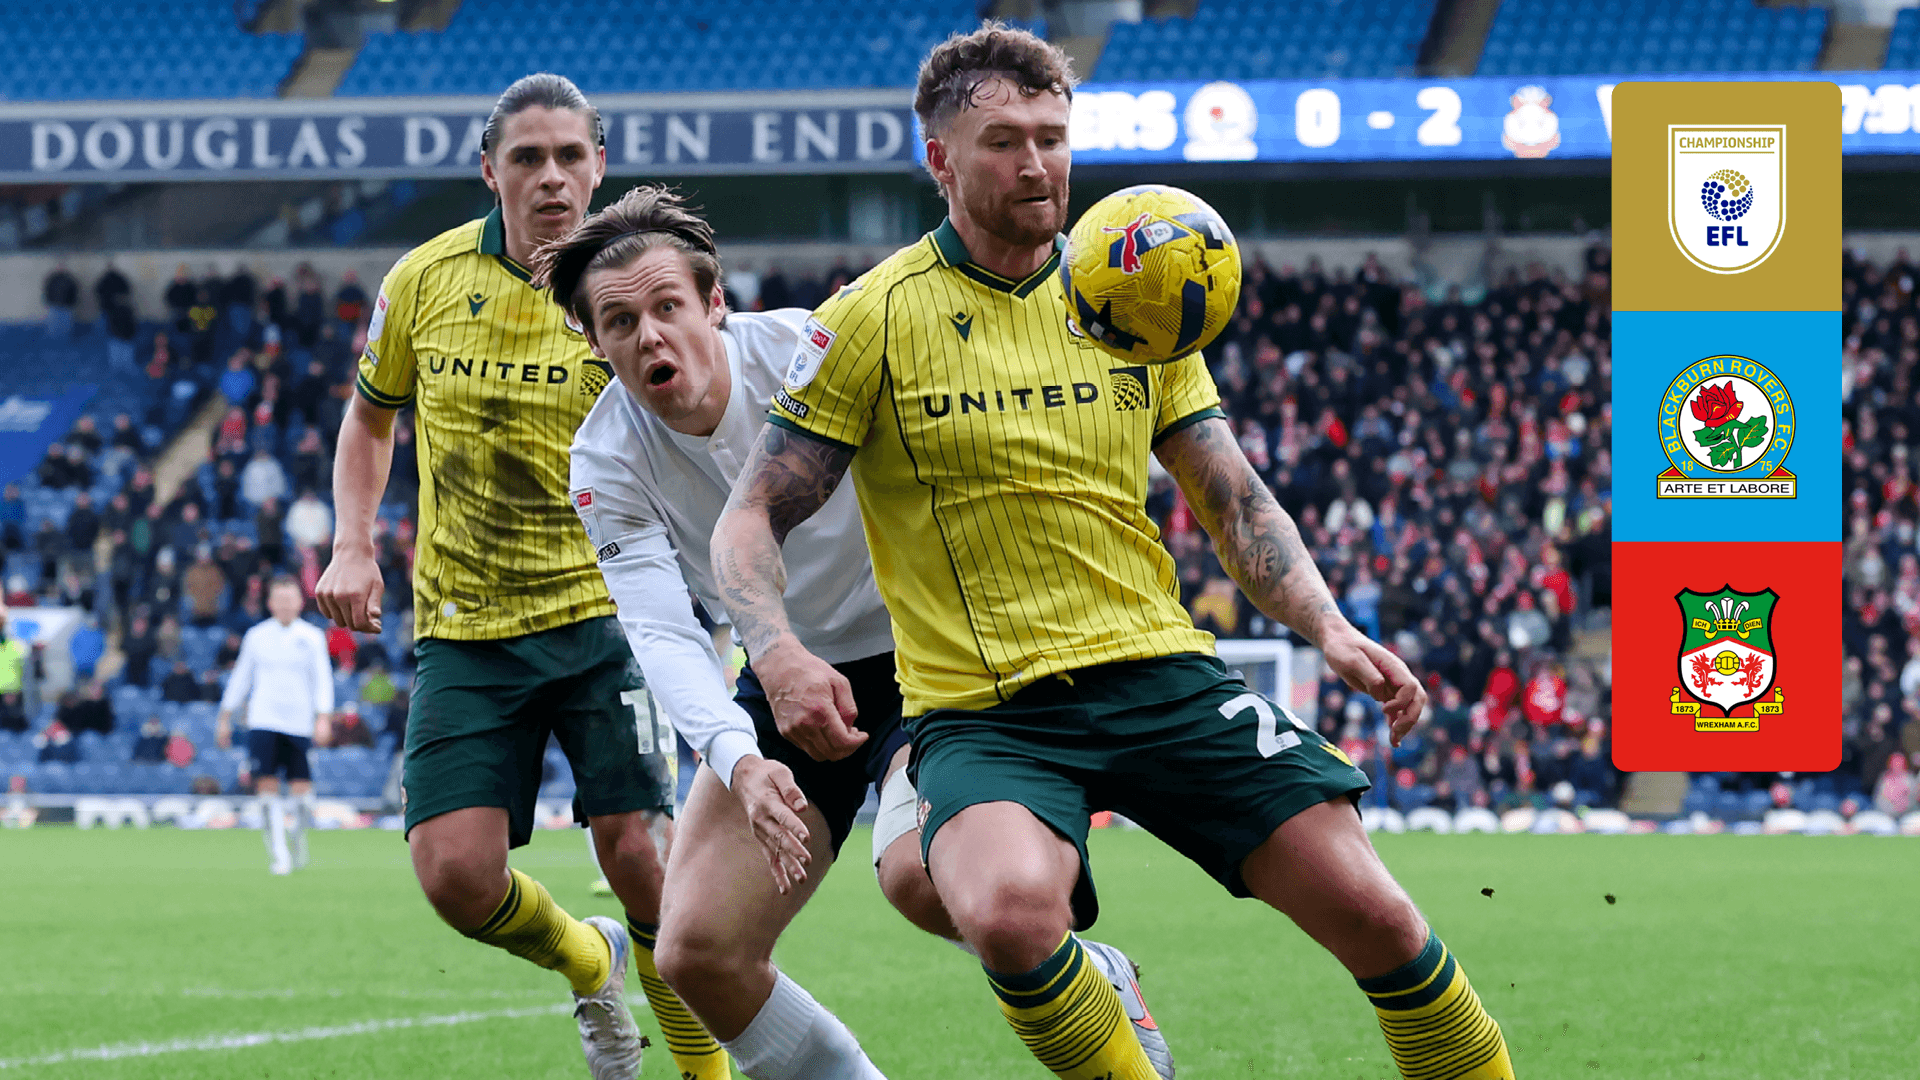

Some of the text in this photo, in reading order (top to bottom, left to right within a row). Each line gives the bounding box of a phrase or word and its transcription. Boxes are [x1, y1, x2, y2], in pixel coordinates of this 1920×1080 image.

[31, 112, 904, 172] DOUGLAS DAEN END
[1295, 88, 1341, 148] 0
[1416, 86, 1463, 146] 2
[429, 356, 569, 385] UNITED
[924, 382, 1098, 417] UNITED
[1218, 693, 1310, 759] 2
